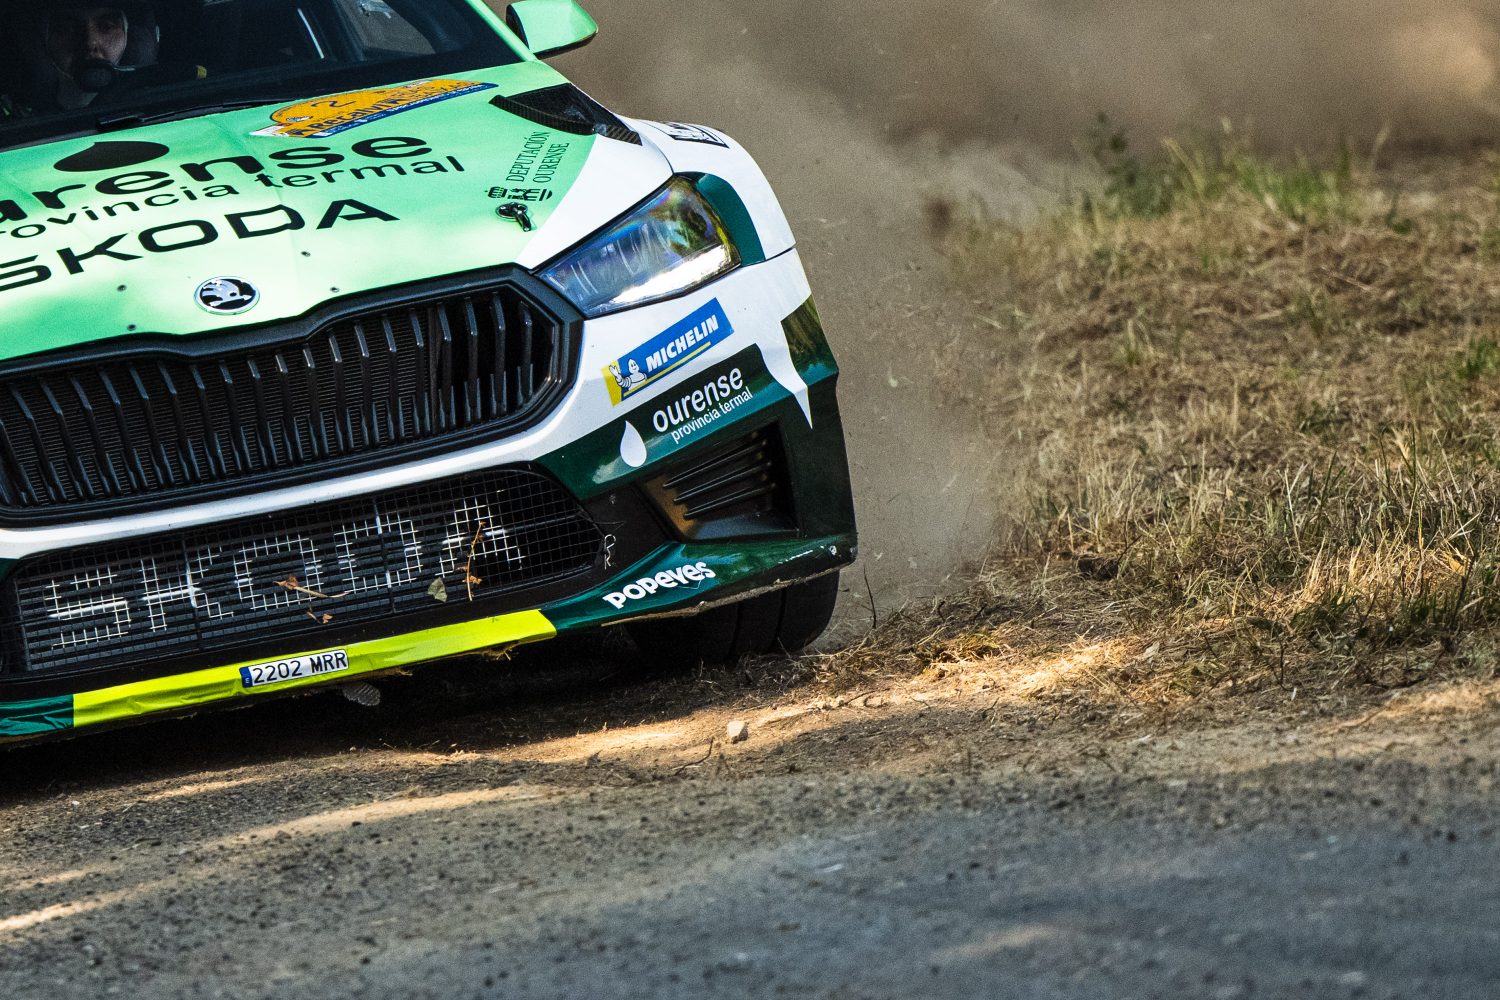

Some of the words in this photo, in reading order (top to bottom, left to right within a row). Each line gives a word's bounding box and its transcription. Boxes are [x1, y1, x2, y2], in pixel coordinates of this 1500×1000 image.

[308, 101, 388, 130] Recalvi
[255, 155, 464, 190] termal
[505, 130, 550, 182] DEPUTACIÓN
[531, 141, 570, 184] OURENSE
[645, 314, 719, 373] MICHELIN
[653, 367, 743, 433] ourense
[671, 409, 722, 444] provincia
[720, 386, 754, 417] termal
[252, 660, 303, 683] 2202
[310, 652, 348, 673] MRR
